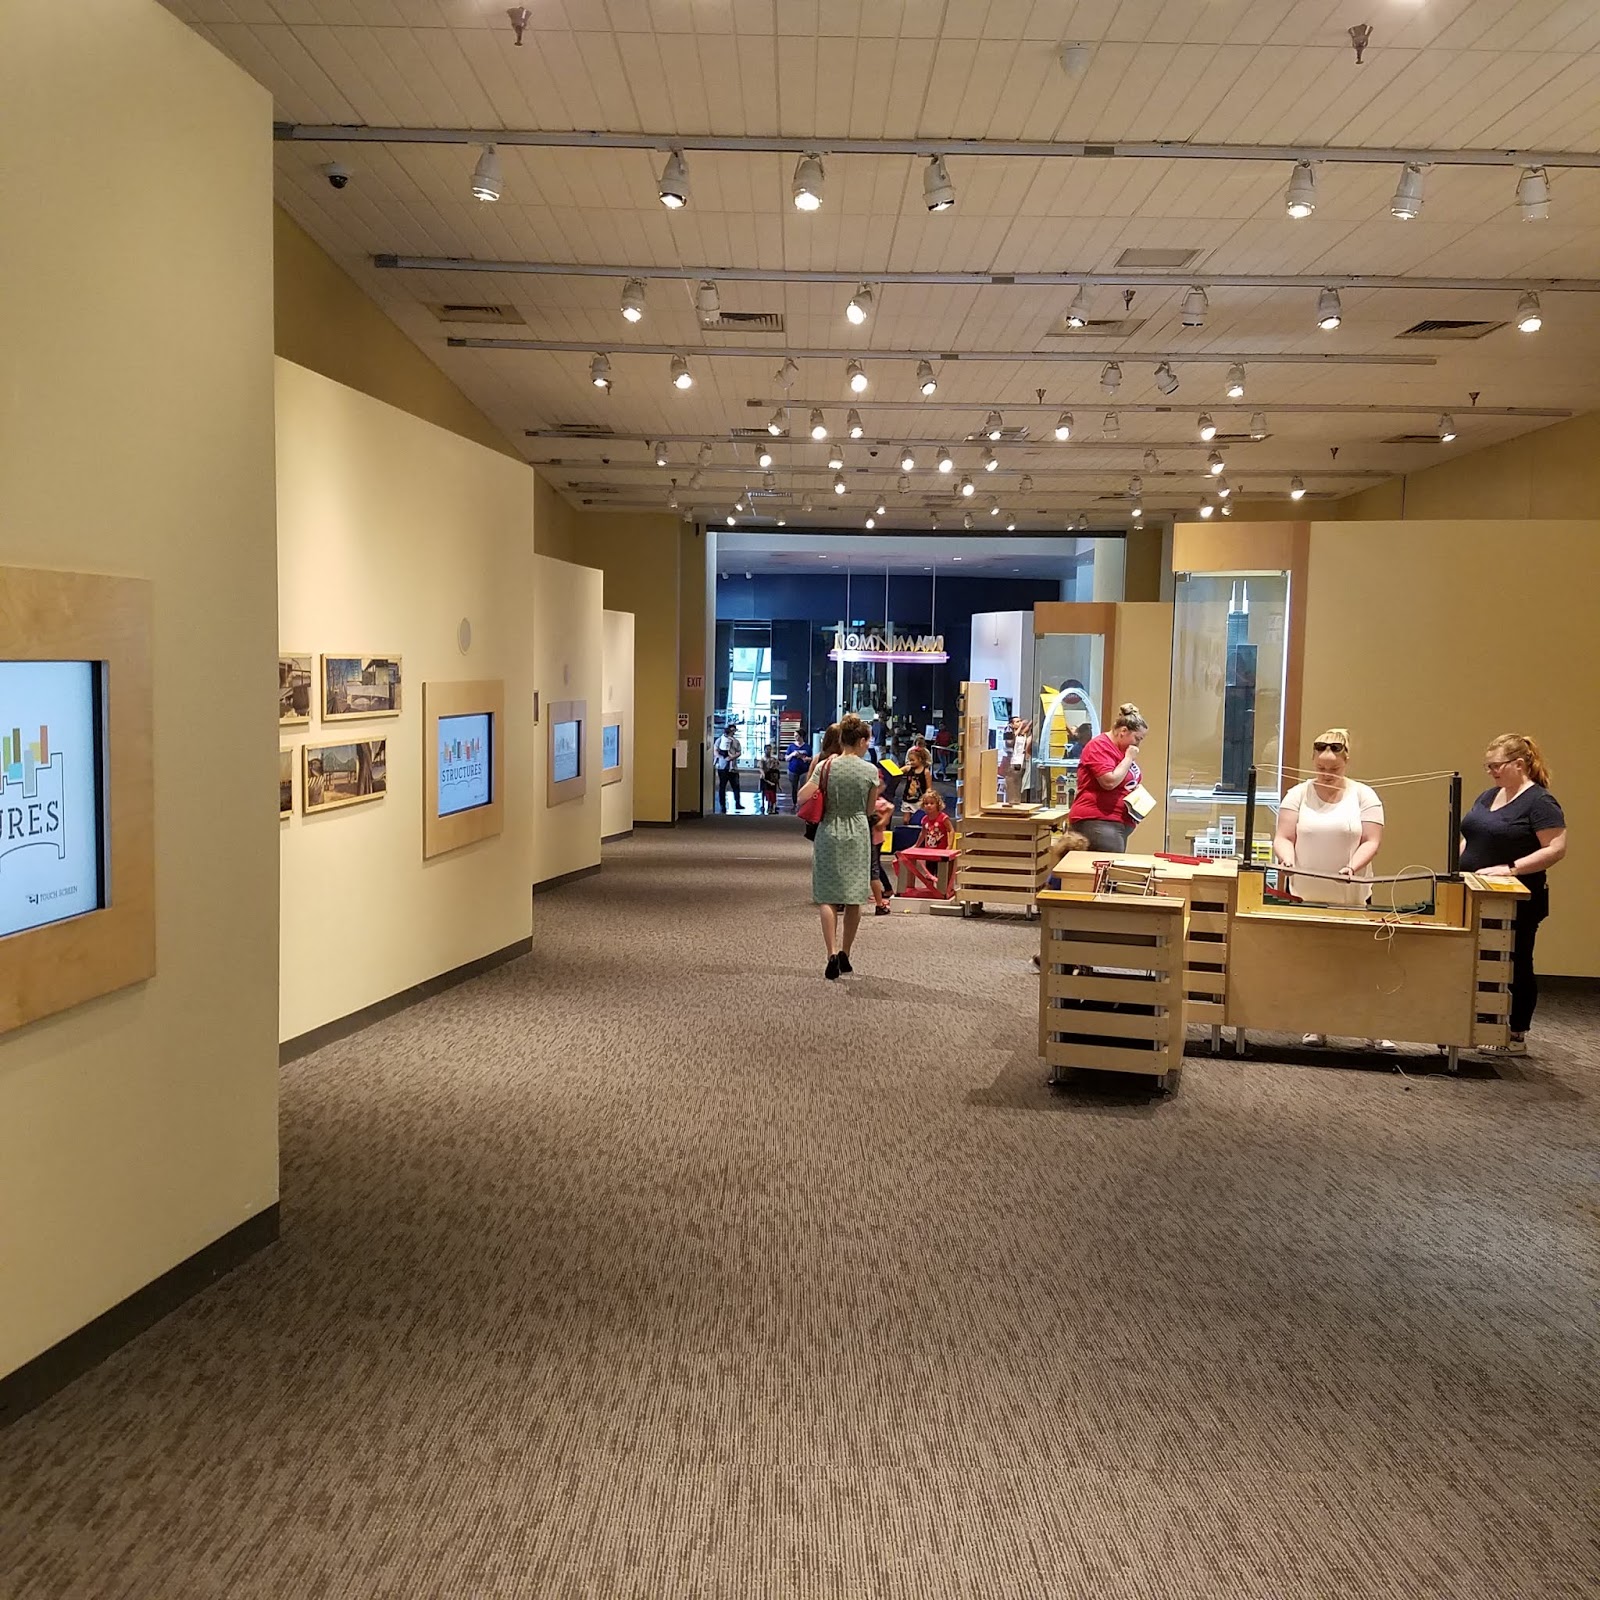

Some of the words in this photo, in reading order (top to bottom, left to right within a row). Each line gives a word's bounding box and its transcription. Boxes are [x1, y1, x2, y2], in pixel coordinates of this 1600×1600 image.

[687, 677, 702, 687] EXIT
[441, 763, 482, 782] STRUCTURES
[0, 800, 59, 839] RES
[40, 890, 58, 902] TOUCH
[58, 885, 78, 897] SCREEN
